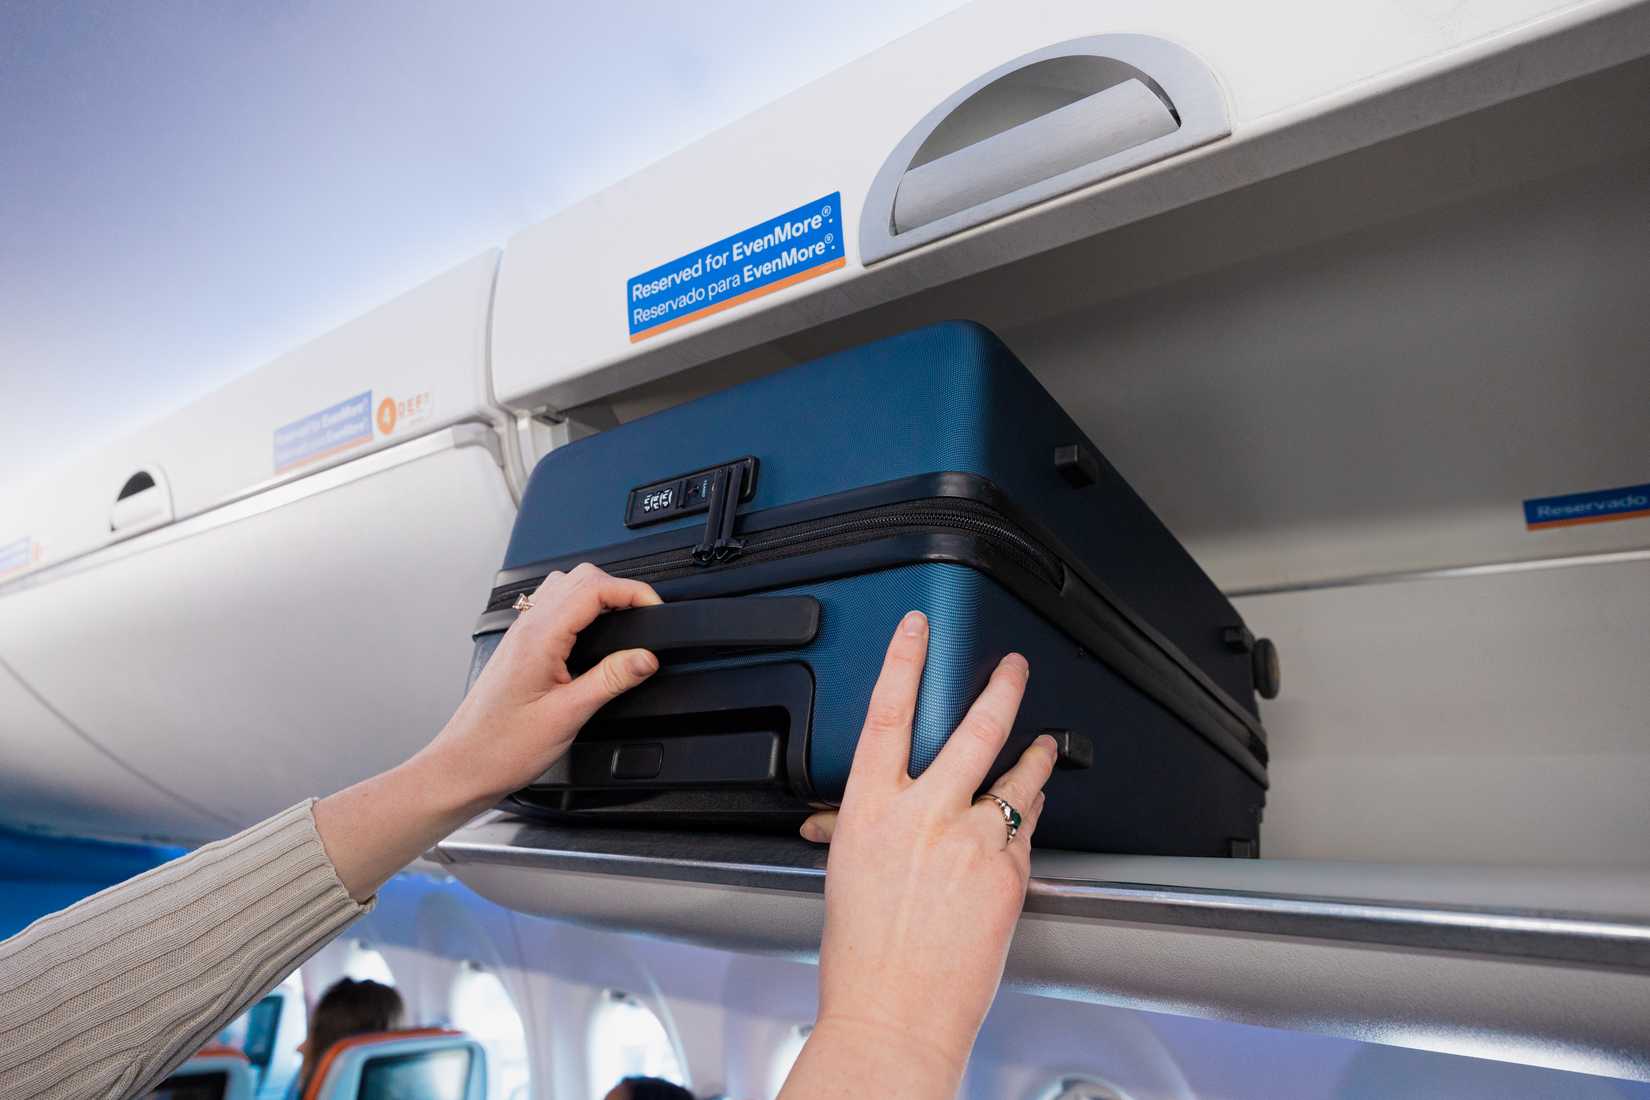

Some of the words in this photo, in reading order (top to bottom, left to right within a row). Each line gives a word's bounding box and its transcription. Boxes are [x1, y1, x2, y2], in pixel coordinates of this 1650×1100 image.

[632, 259, 702, 302] Reserved
[705, 252, 729, 273] for
[634, 286, 705, 325] Reservado
[708, 273, 740, 301] para
[1536, 494, 1649, 515] Reservado
